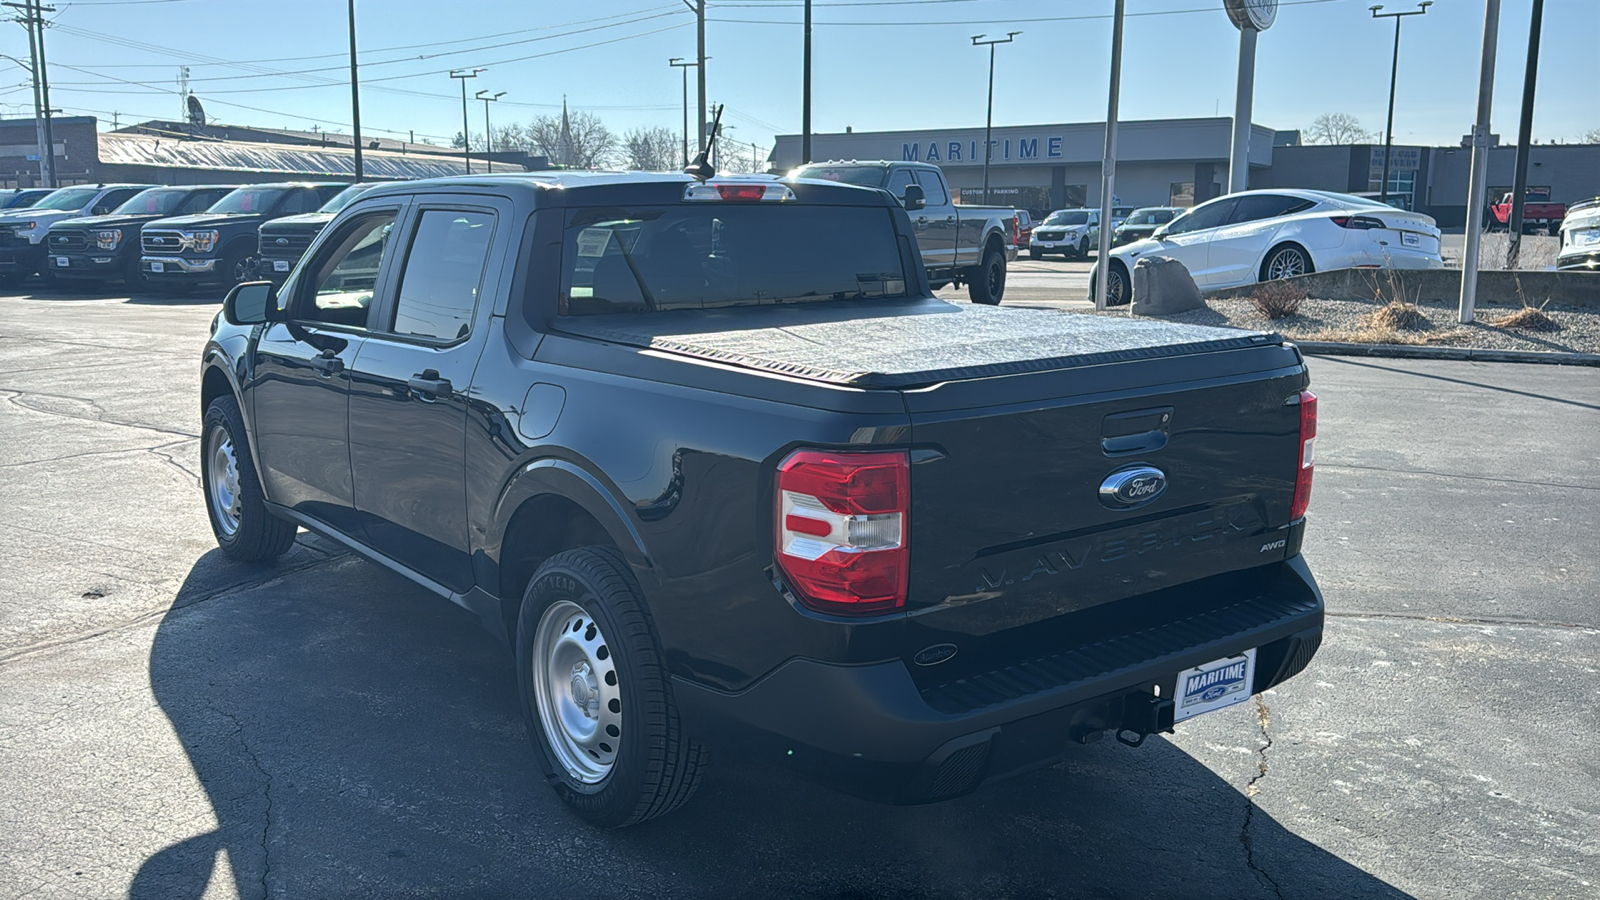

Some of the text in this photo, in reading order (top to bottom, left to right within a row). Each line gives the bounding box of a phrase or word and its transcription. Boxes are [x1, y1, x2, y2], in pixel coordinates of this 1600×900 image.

[902, 137, 1063, 162] MARITIME
[1371, 159, 1417, 167] DEIVERY
[1128, 476, 1158, 498] Ford
[1259, 539, 1286, 553] AWD
[1186, 662, 1245, 695] MARITIME
[1204, 688, 1223, 700] Ford
